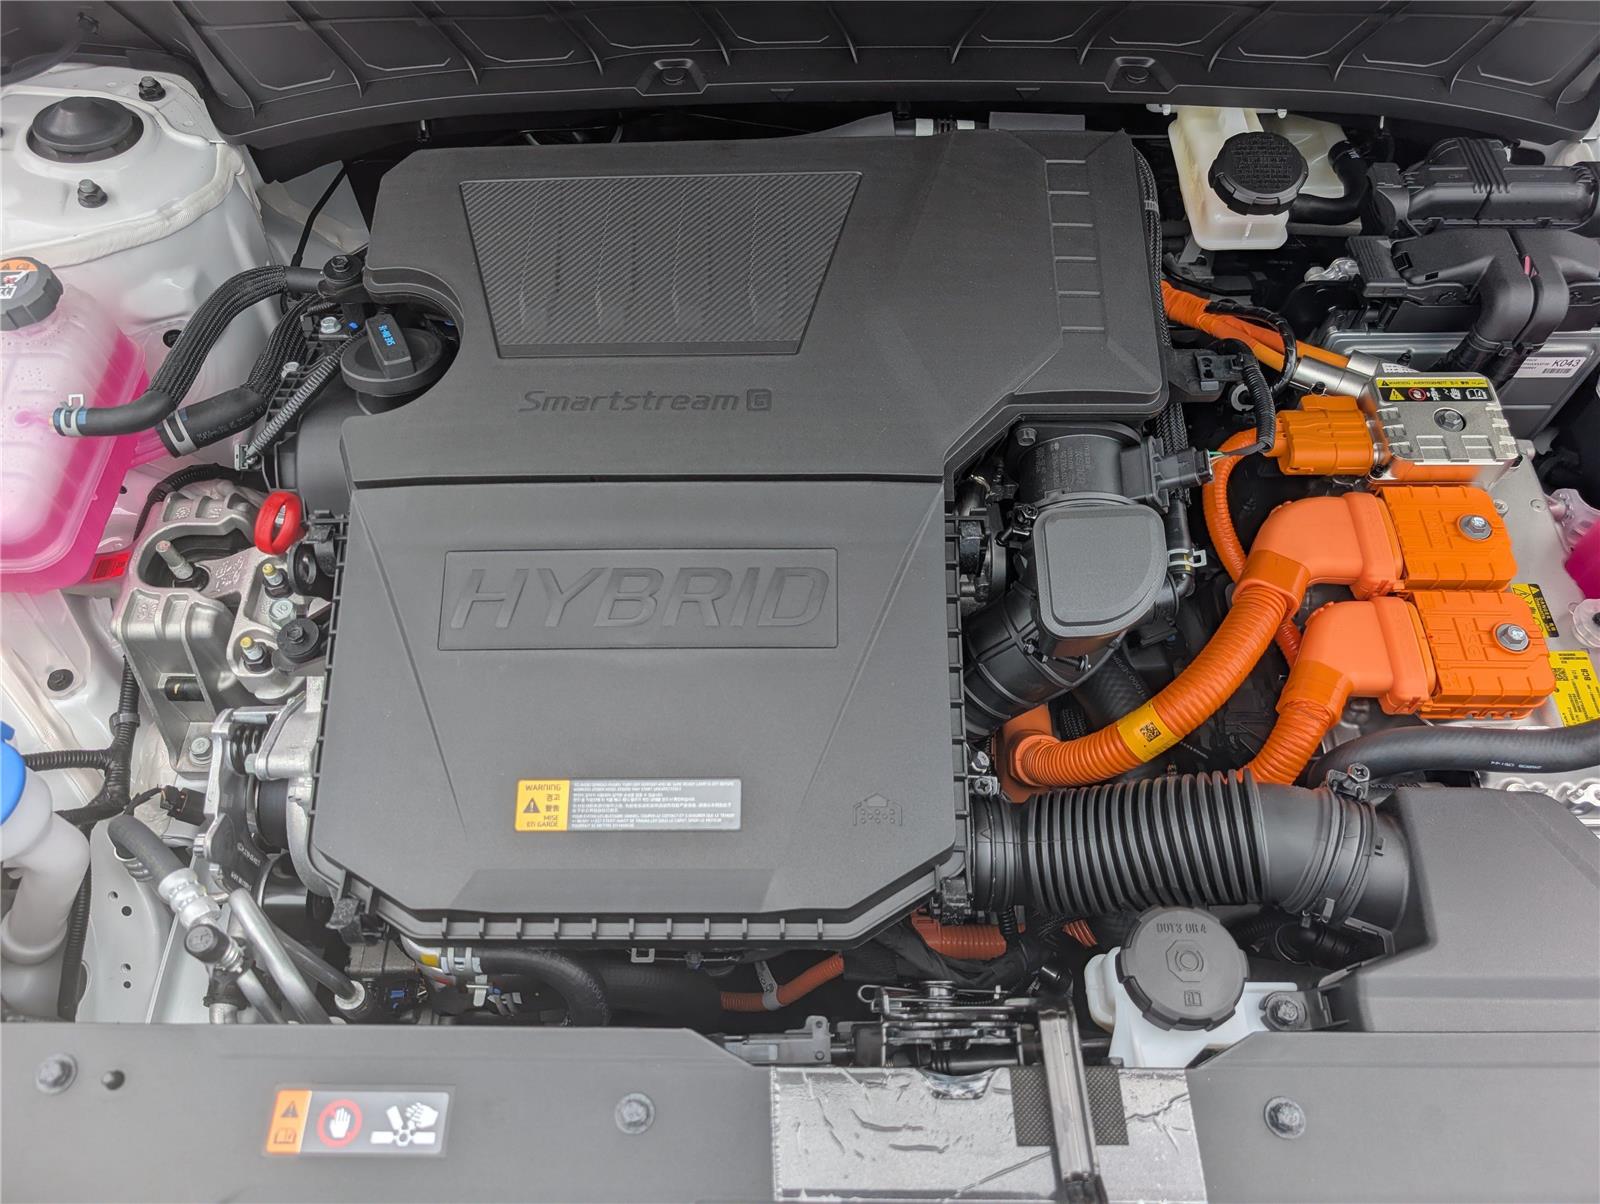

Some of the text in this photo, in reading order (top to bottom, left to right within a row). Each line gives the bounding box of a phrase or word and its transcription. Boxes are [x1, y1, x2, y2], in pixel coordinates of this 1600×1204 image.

[1551, 359, 1581, 368] K043
[518, 390, 740, 413] Smartstream
[450, 567, 830, 629] HYBRID
